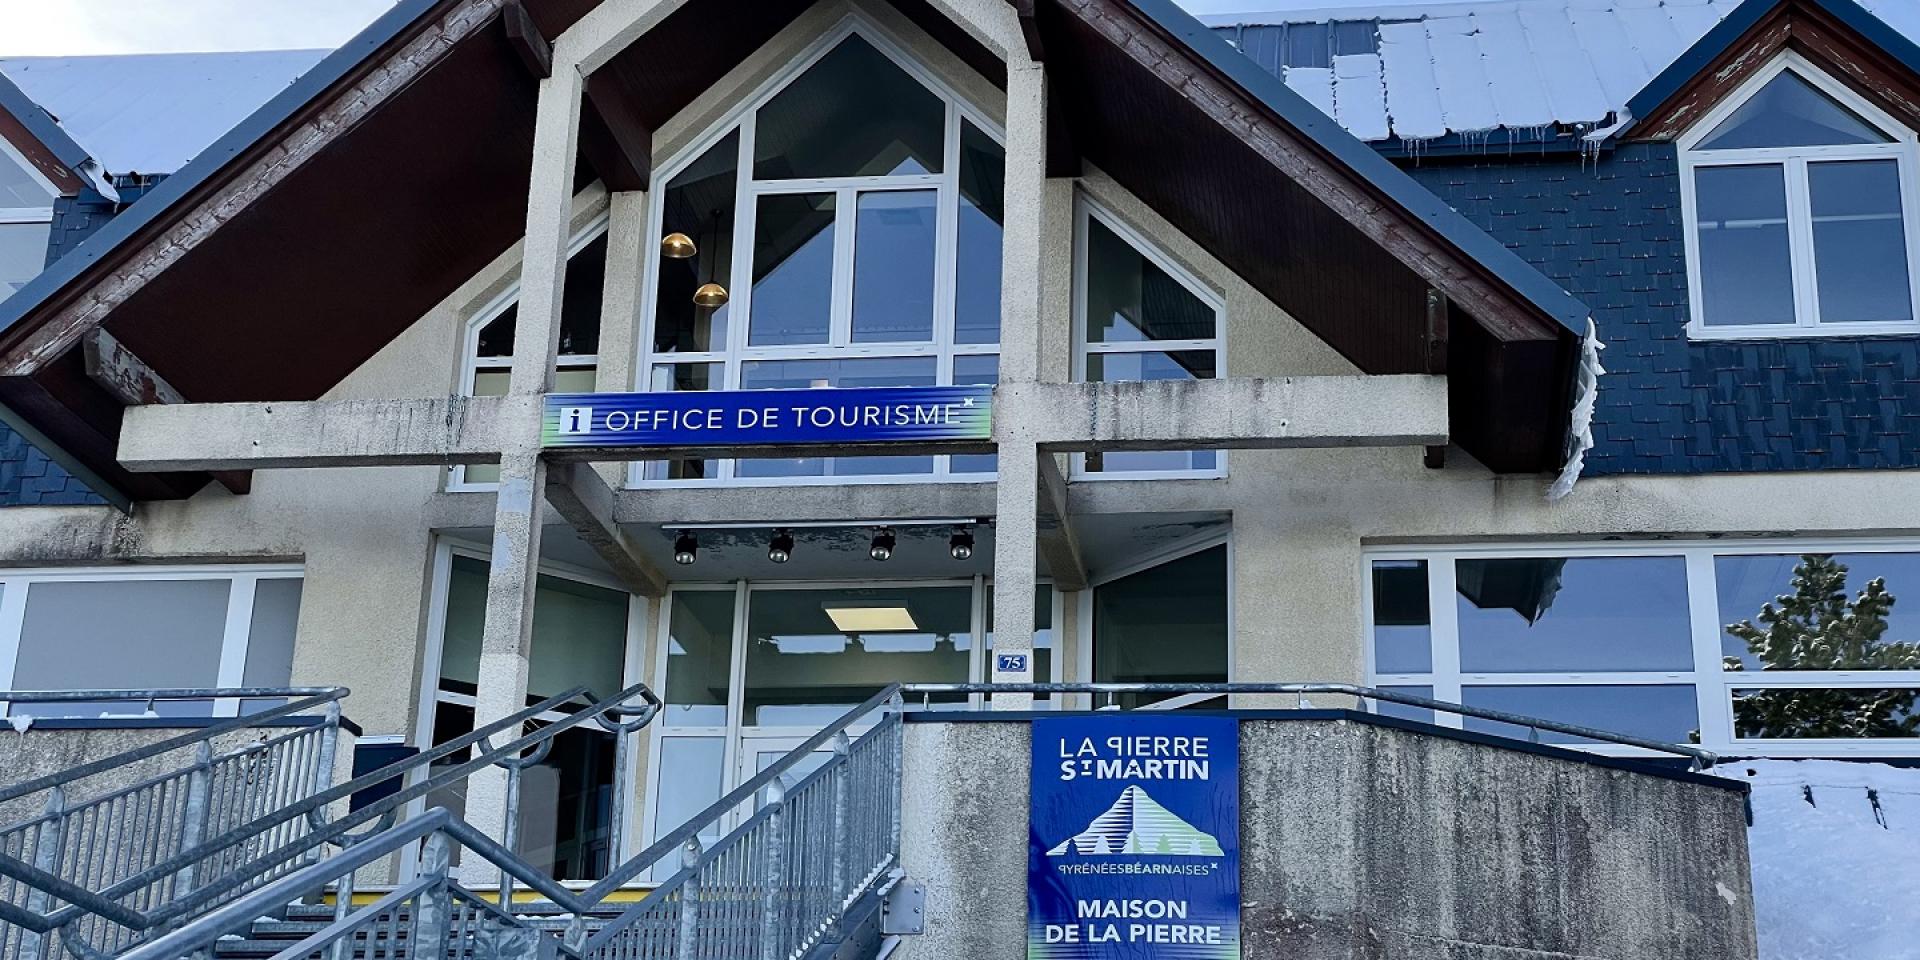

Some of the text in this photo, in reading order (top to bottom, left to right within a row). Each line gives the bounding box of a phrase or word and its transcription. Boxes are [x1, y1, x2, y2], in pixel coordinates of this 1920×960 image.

[605, 408, 724, 431] OFFICE
[737, 407, 779, 429] DE
[790, 404, 961, 428] TOURISME
[1003, 656, 1021, 669] 75
[1060, 736, 1209, 758] LA PIERRE
[1078, 900, 1187, 919] MAISON
[1045, 924, 1222, 945] DE LA PIERRE
